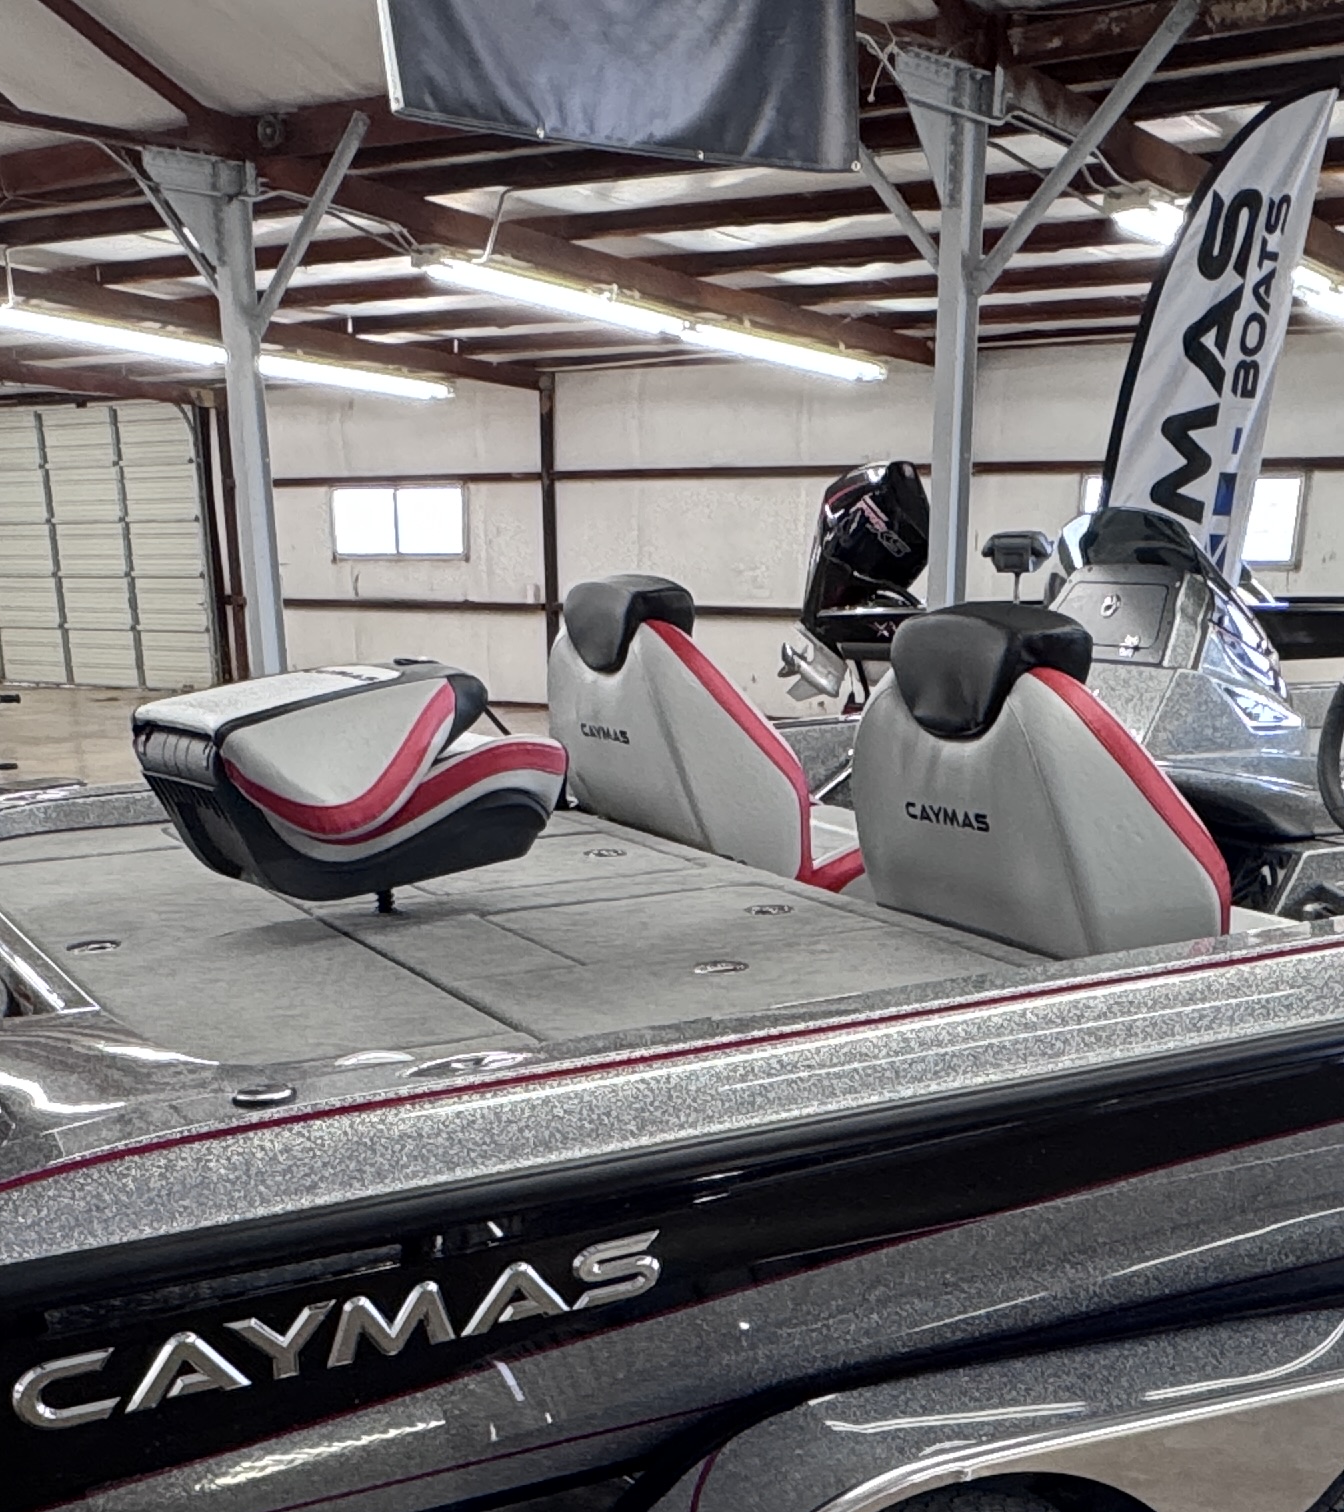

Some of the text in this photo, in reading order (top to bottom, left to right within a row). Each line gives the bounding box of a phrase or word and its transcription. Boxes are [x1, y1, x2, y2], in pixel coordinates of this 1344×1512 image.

[1231, 193, 1292, 400] BOATS
[580, 722, 630, 745] CAYMAS
[905, 801, 990, 833] CAYMAS
[12, 1229, 661, 1431] CAYMAS
